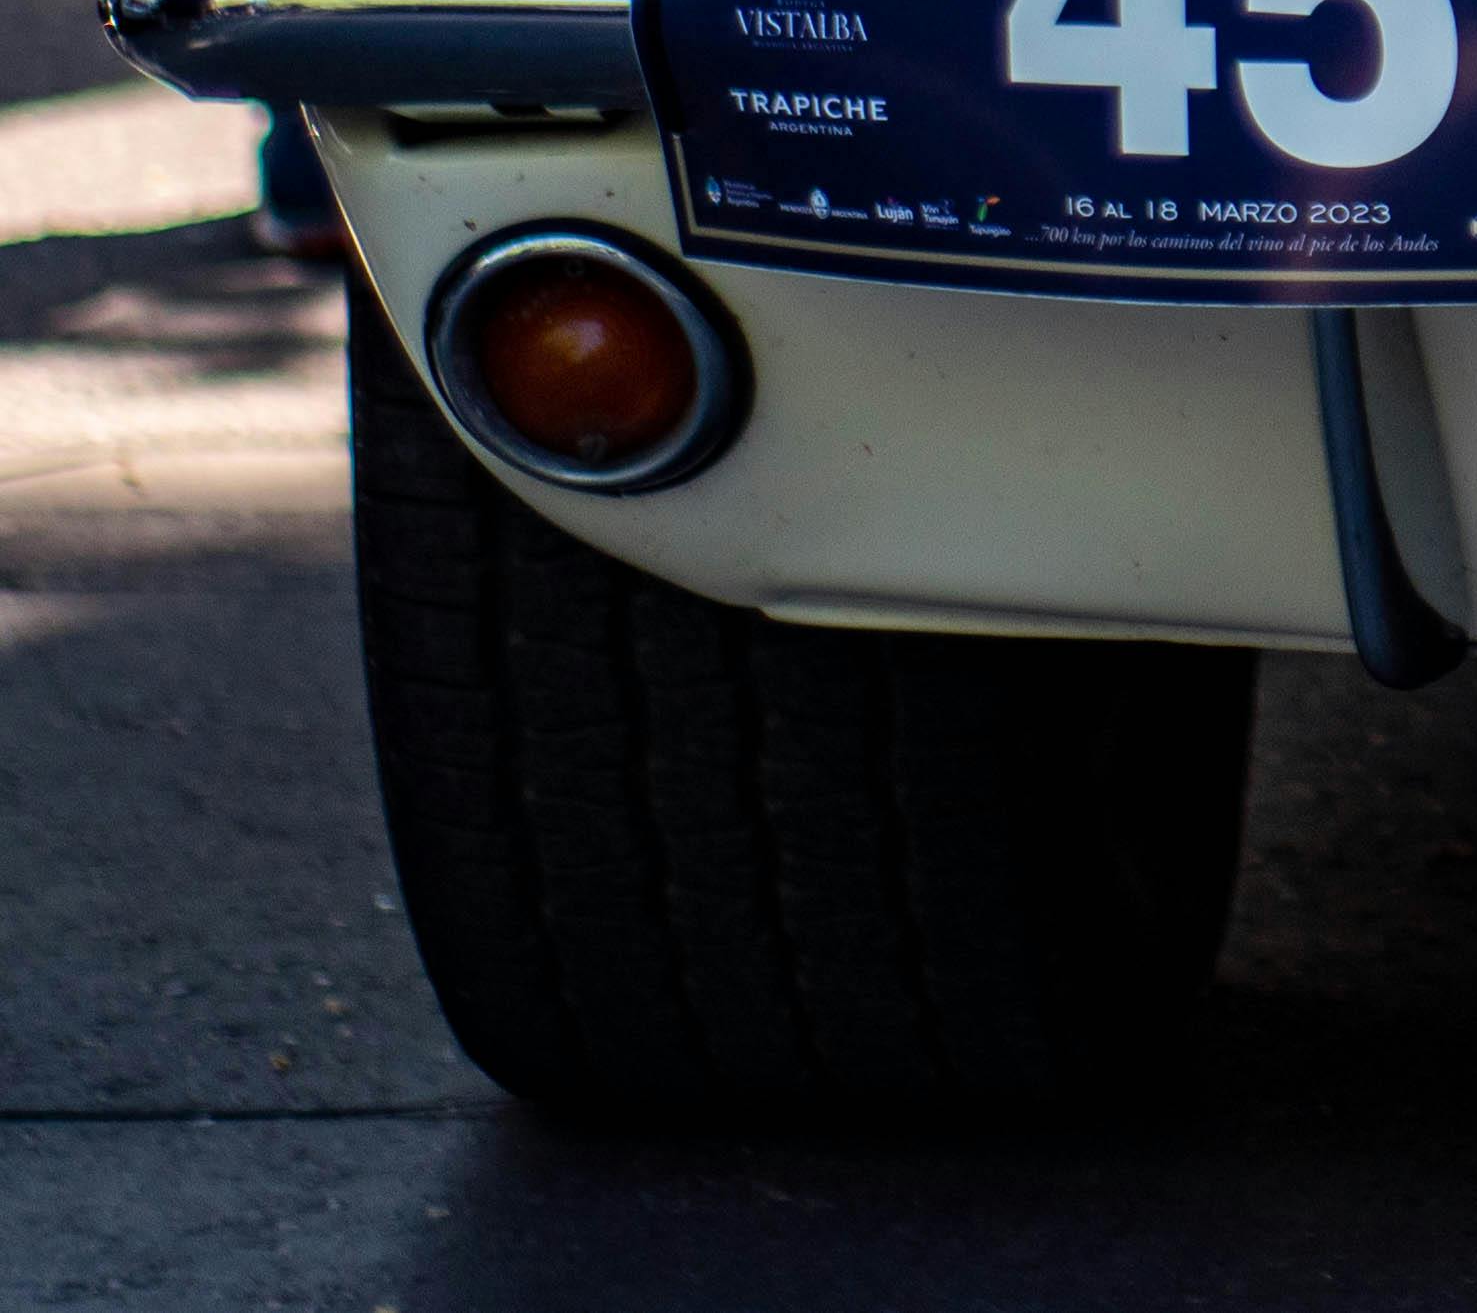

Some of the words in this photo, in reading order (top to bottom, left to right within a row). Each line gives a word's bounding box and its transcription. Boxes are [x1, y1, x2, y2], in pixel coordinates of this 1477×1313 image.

[735, 7, 868, 42] VISTALBA
[729, 90, 888, 122] TRAPICHE
[768, 121, 853, 136] ARGENTINA
[1066, 196, 1094, 218] 16
[1103, 202, 1133, 219] AL
[1147, 199, 1178, 221] 18
[1200, 201, 1298, 224] MARZO
[1310, 202, 1392, 224] 2023
[1072, 226, 1095, 245] km
[1099, 231, 1126, 251] por
[1128, 229, 1148, 248] los
[1151, 232, 1215, 250] caminos
[1219, 232, 1244, 252] del
[1249, 234, 1284, 251] vino
[1288, 233, 1306, 252] al
[1309, 235, 1335, 257] pie
[1339, 234, 1355, 253] de
[1363, 234, 1385, 253] los
[1389, 233, 1440, 253] Andes
